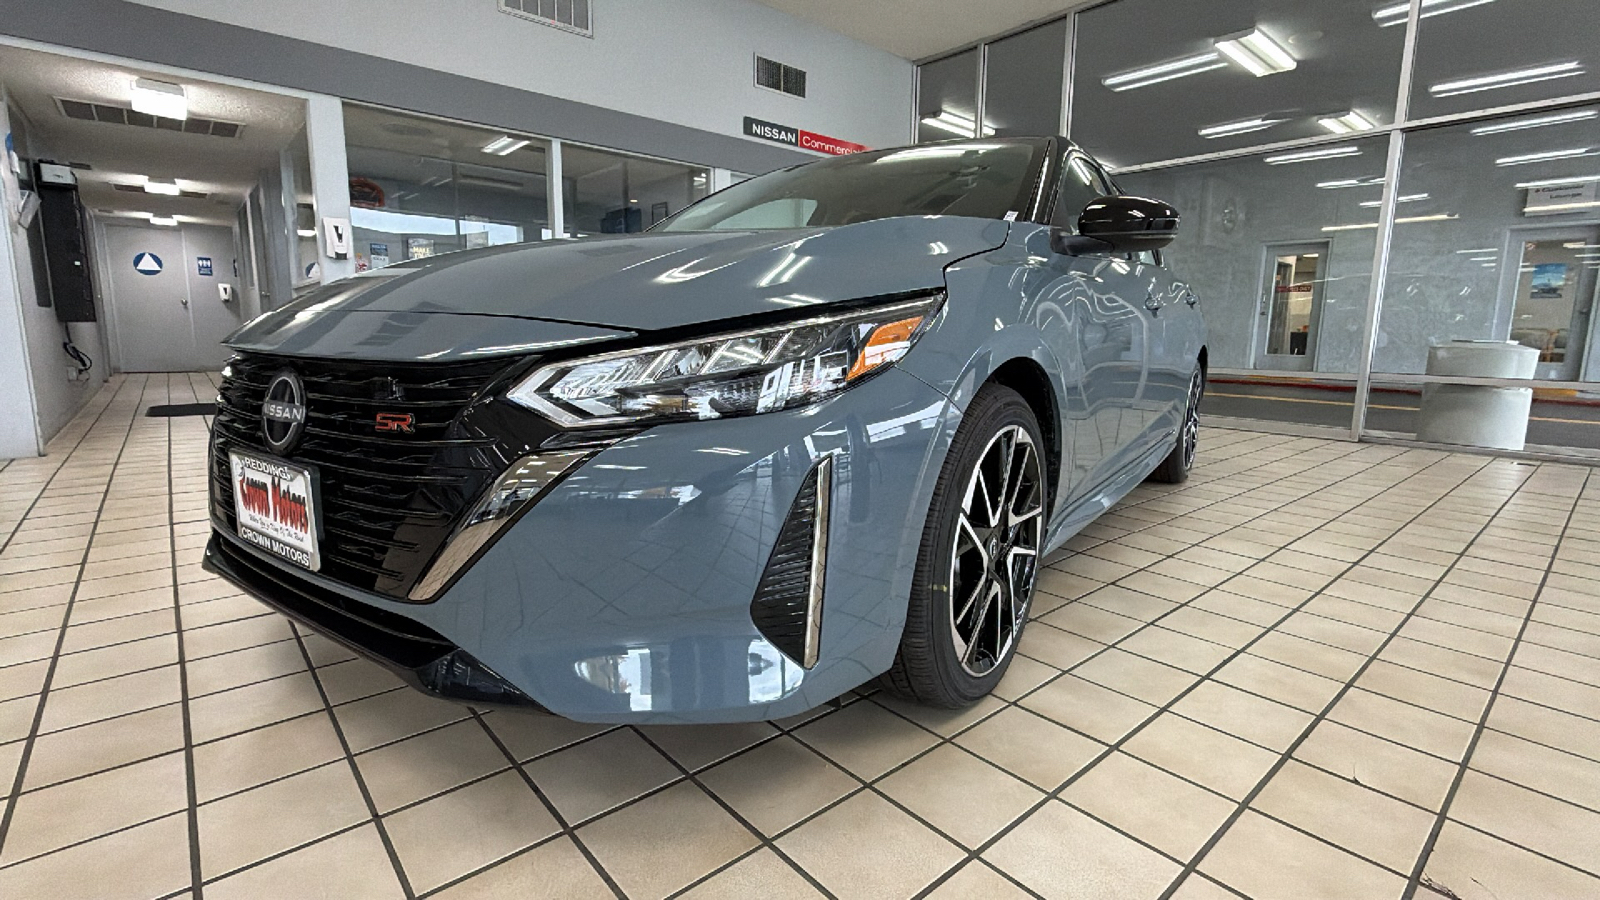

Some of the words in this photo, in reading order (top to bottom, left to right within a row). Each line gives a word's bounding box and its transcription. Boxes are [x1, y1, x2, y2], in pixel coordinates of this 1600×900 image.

[752, 123, 796, 143] NISSAN
[375, 413, 411, 432] SR
[241, 527, 271, 549] CROWN
[271, 540, 309, 566] MOTORS
